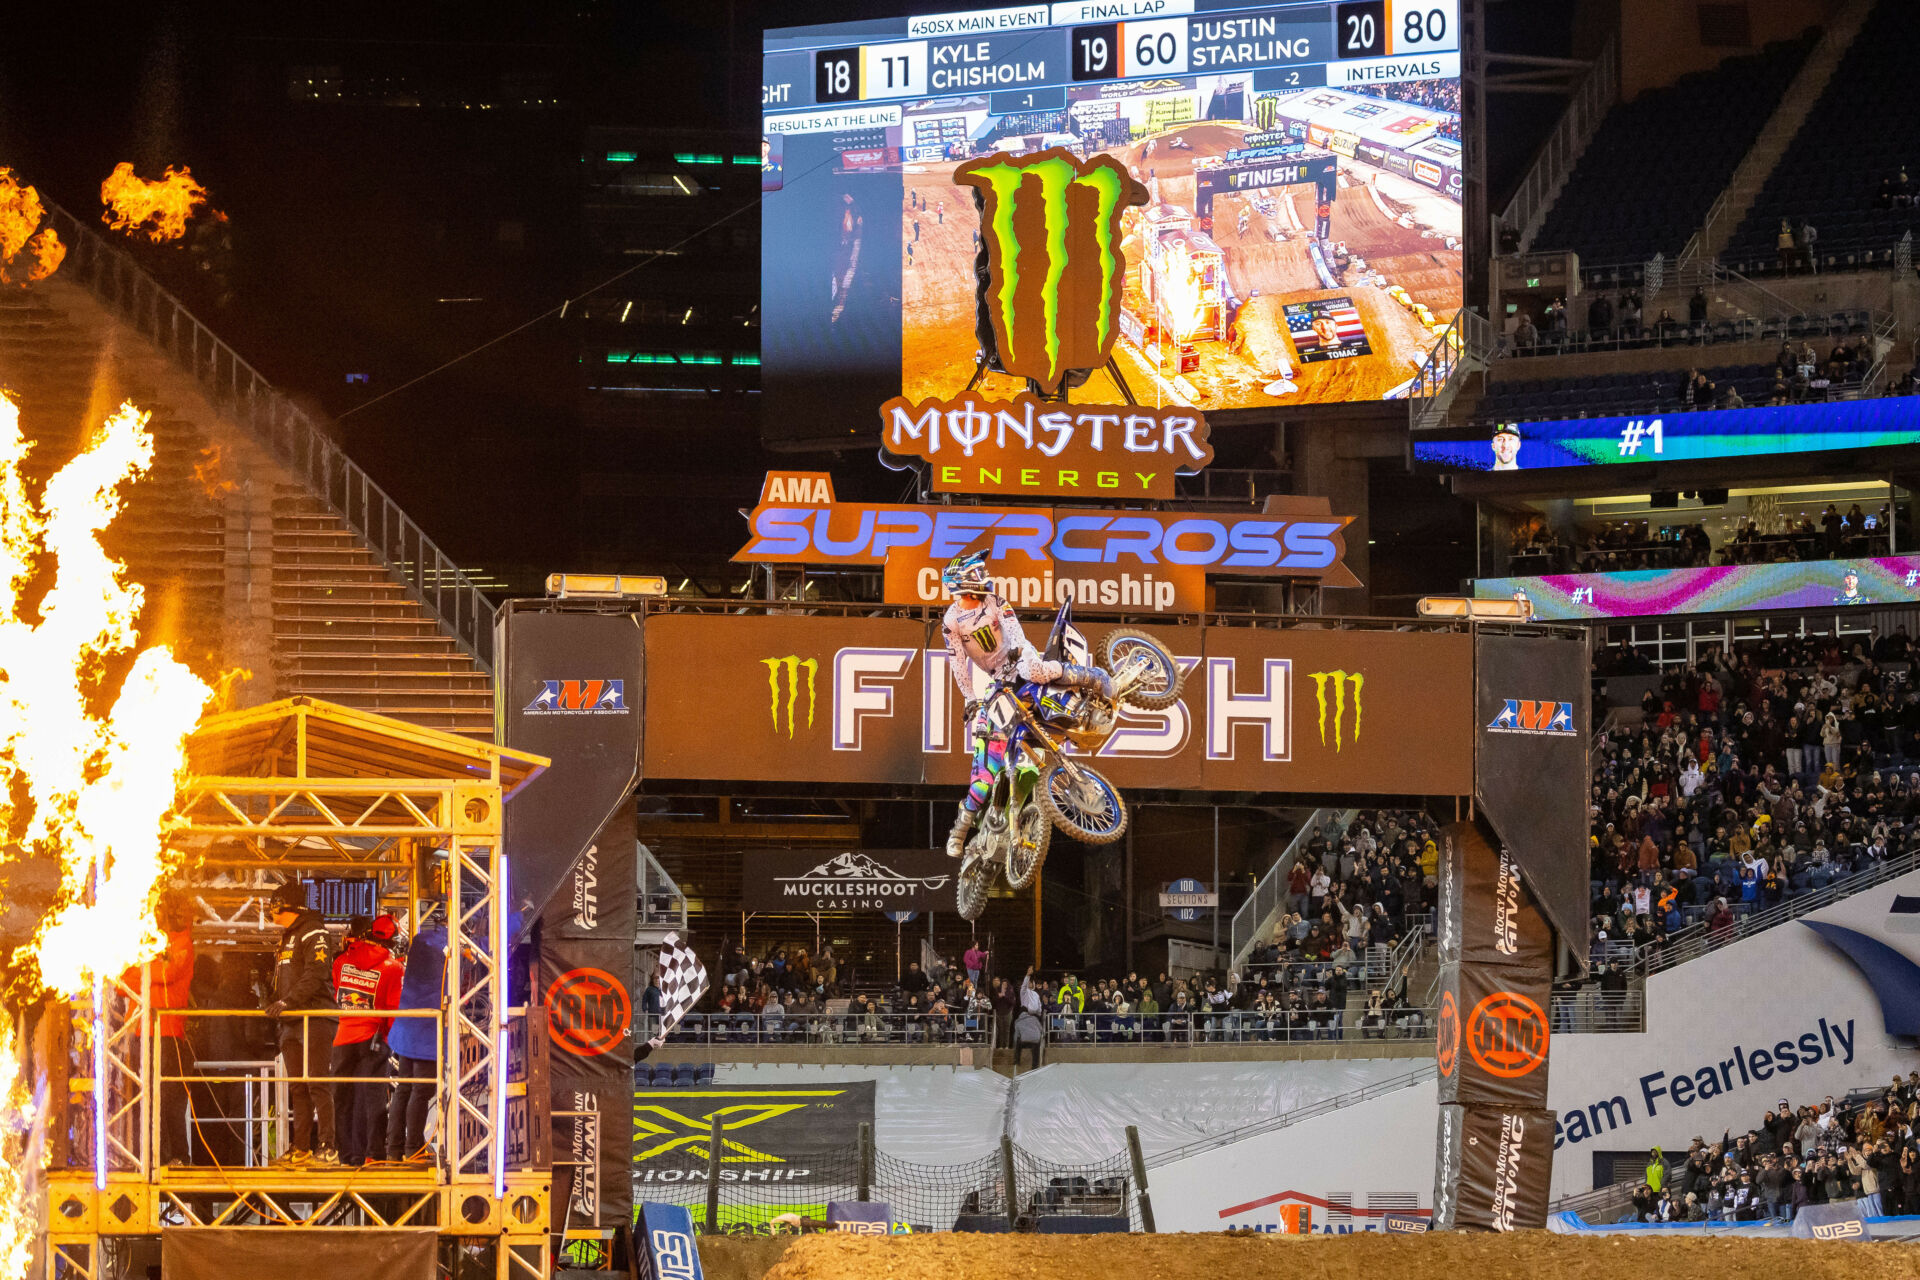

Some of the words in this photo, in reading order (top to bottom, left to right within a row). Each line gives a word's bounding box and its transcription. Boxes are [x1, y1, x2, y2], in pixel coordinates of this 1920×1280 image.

[912, 18, 954, 35] 450SX
[958, 15, 997, 32] MAIN
[1000, 11, 1046, 28] EVENT
[1081, 3, 1130, 20] FINAL
[1135, 1, 1165, 16] LAP
[1192, 17, 1276, 42] JUSTIN
[1347, 13, 1376, 50] 20
[1404, 8, 1447, 44] 80
[933, 42, 991, 65] KYLE
[1081, 38, 1109, 73] 19
[1136, 32, 1177, 66] 60
[1192, 38, 1310, 66] STARLING
[824, 60, 851, 95] 18
[881, 55, 911, 89] 11
[932, 61, 1046, 89] CHISHOLM
[1284, 71, 1300, 86] -2
[1346, 61, 1441, 81] INTERVALS
[1022, 94, 1034, 107] -1
[769, 118, 822, 133] RESULTS
[825, 117, 840, 128] AT
[843, 114, 866, 126] THE
[870, 111, 897, 124] LINE
[1244, 131, 1287, 143] MONSTER
[1333, 136, 1356, 151] SUZUK
[1237, 165, 1298, 188] FINISH
[1327, 349, 1358, 359] TOMAC
[890, 400, 1207, 460] MONSTER
[1618, 418, 1664, 455] #1
[767, 477, 831, 503] AMA
[942, 467, 1157, 490] ENERGY
[748, 508, 1346, 568] SUPERCROSS
[917, 567, 1175, 611] Cmpionship
[1572, 587, 1593, 605] #1
[522, 680, 630, 710] AMA
[993, 700, 1006, 726] 1
[1486, 699, 1578, 732] AMA
[1497, 843, 1509, 897] MOUNTA
[573, 871, 584, 911] ROCKY
[783, 883, 918, 896] MUCKLESHOOT
[1180, 880, 1194, 892] 100
[816, 899, 883, 909] CASINO
[1167, 894, 1208, 905] SECTIONS
[1181, 908, 1194, 920] 102
[1494, 898, 1506, 937] ROCKY
[342, 974, 375, 989] GASGAS
[1640, 1017, 1855, 1116] Fearlessly
[1496, 1113, 1511, 1176] MOUNTAIN
[1491, 1177, 1504, 1216] ROCKY
[1388, 1218, 1428, 1234] WPS
[1812, 1220, 1863, 1240] WPS
